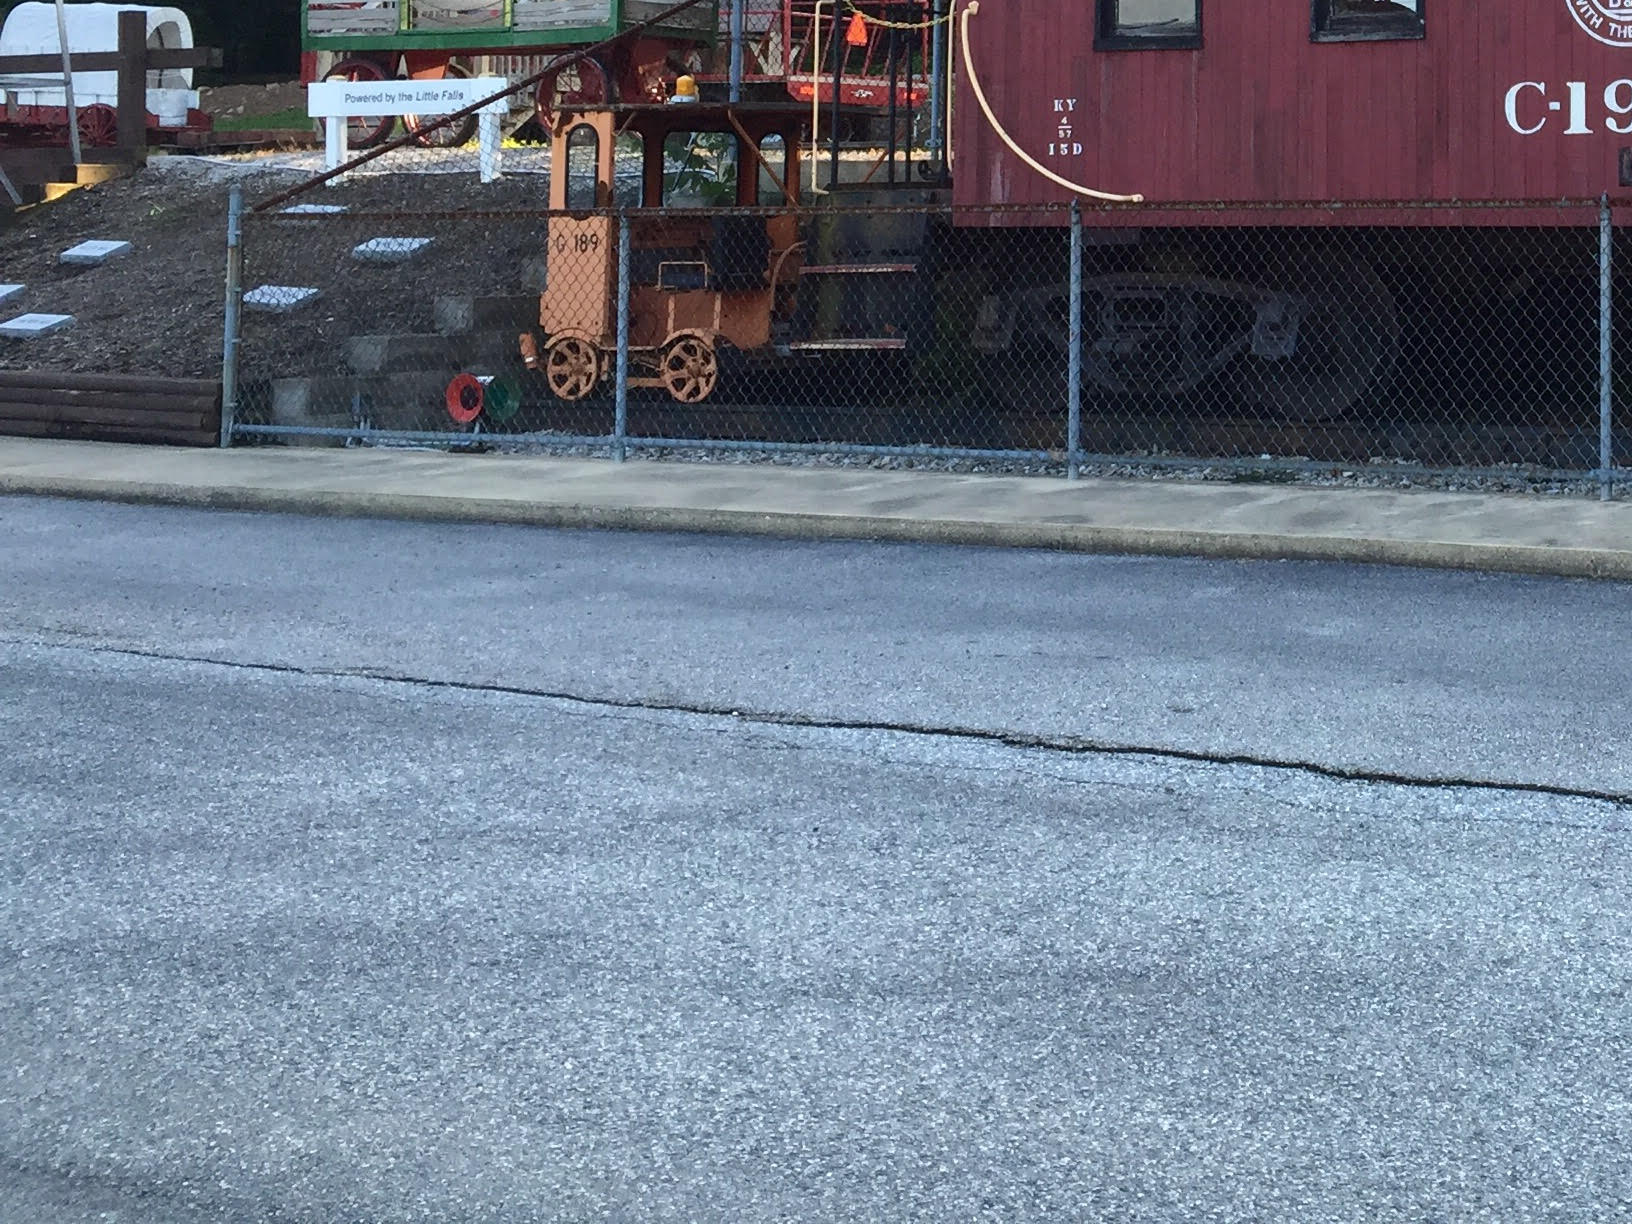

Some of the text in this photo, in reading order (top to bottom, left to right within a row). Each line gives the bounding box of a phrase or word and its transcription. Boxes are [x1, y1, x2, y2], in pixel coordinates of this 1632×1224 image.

[344, 89, 464, 104] Powered by the Little Falls
[1053, 98, 1077, 112] KY
[574, 233, 599, 253] 189
